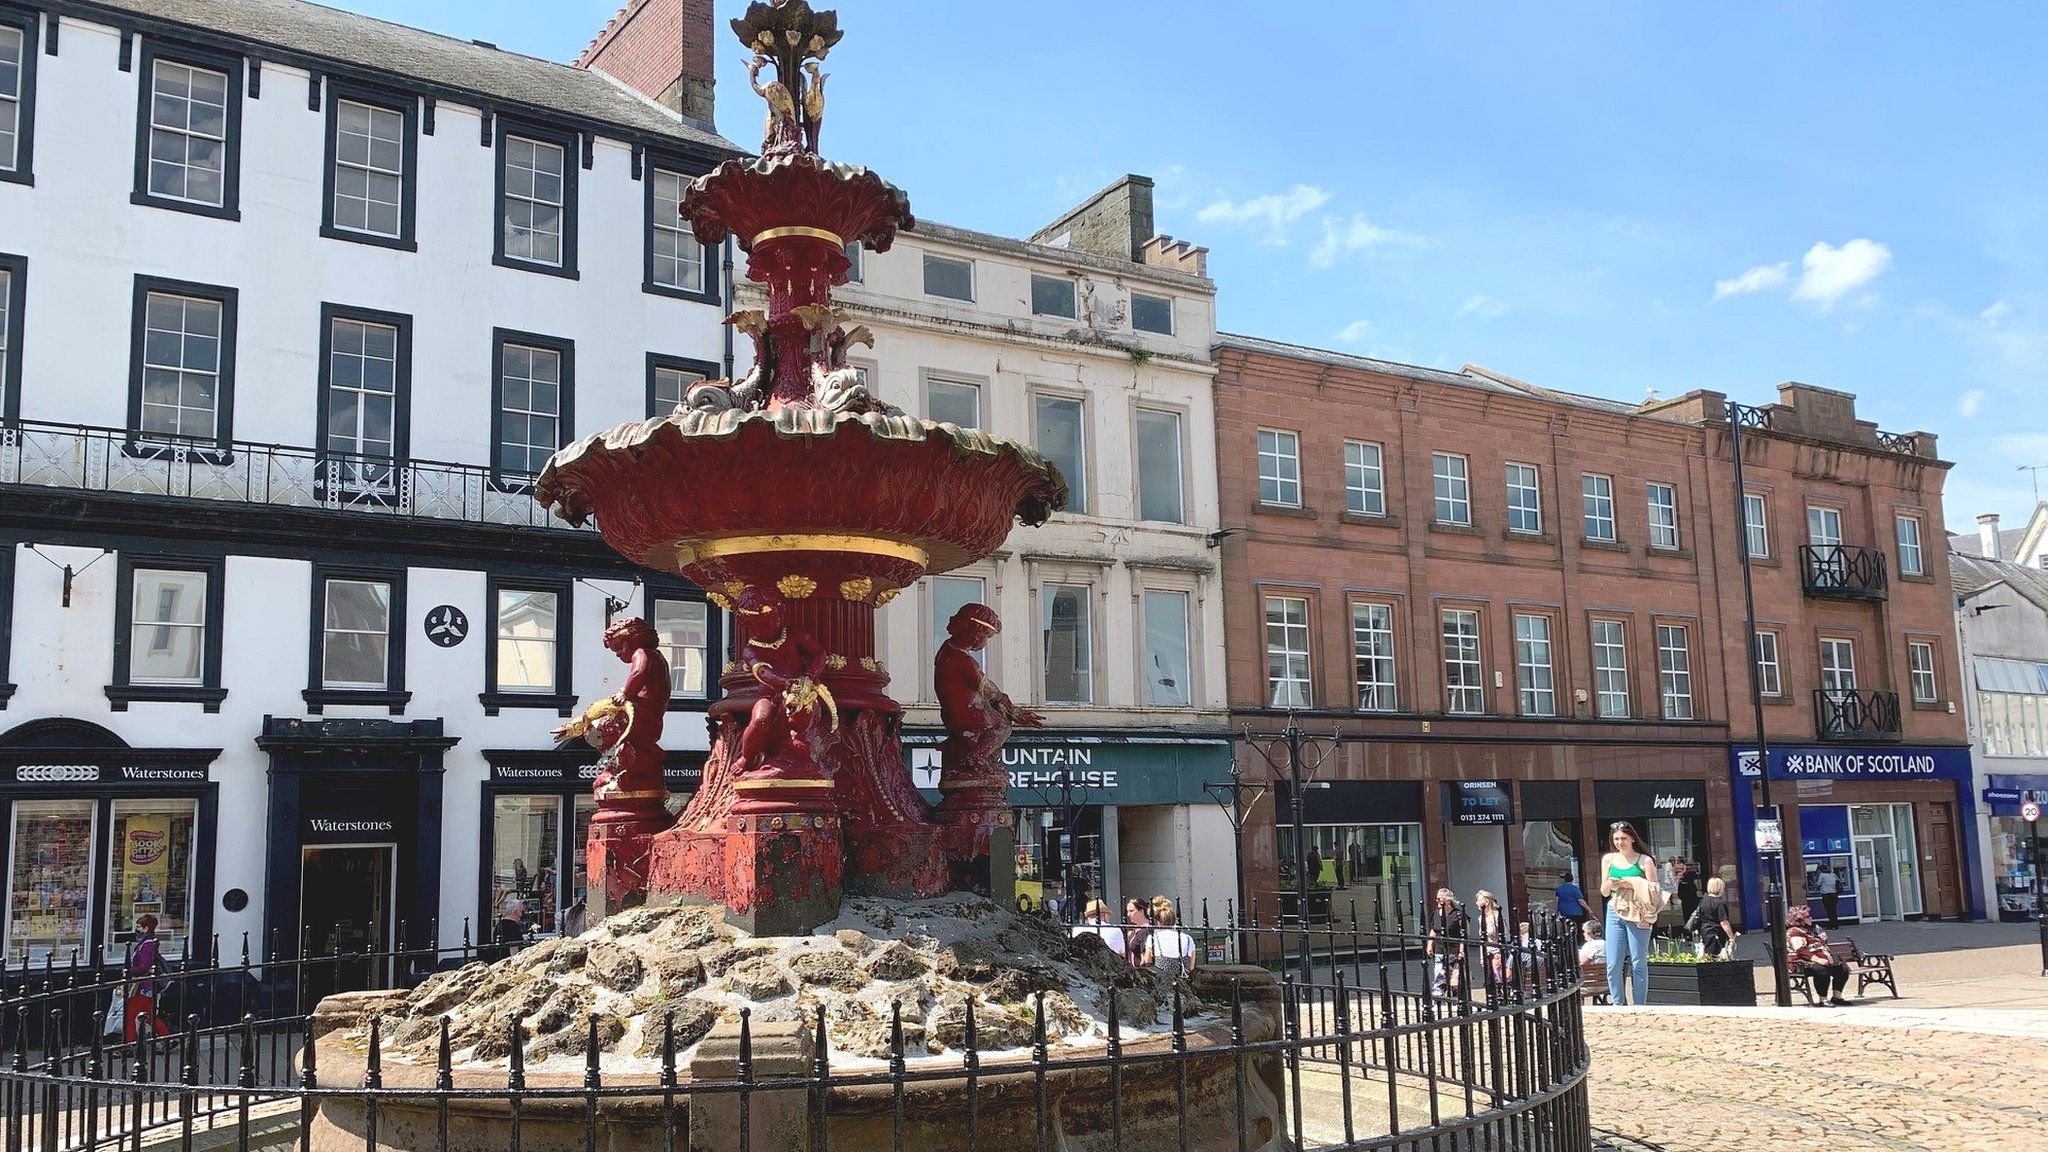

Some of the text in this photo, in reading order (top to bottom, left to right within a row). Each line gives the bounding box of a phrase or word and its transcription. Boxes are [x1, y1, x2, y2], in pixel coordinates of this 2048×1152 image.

[998, 748, 1091, 765] UNTAIN
[1805, 755, 1935, 774] BANK OF SCOTLAND
[122, 766, 204, 779] Waterstones
[496, 766, 563, 778] Waterstones
[662, 768, 701, 777] aterston
[1008, 771, 1118, 788] REHOUSE
[1462, 796, 1499, 806] TO LET
[1653, 793, 1695, 815] bodycare
[2025, 807, 2037, 816] 20
[311, 819, 392, 832] Waterstones
